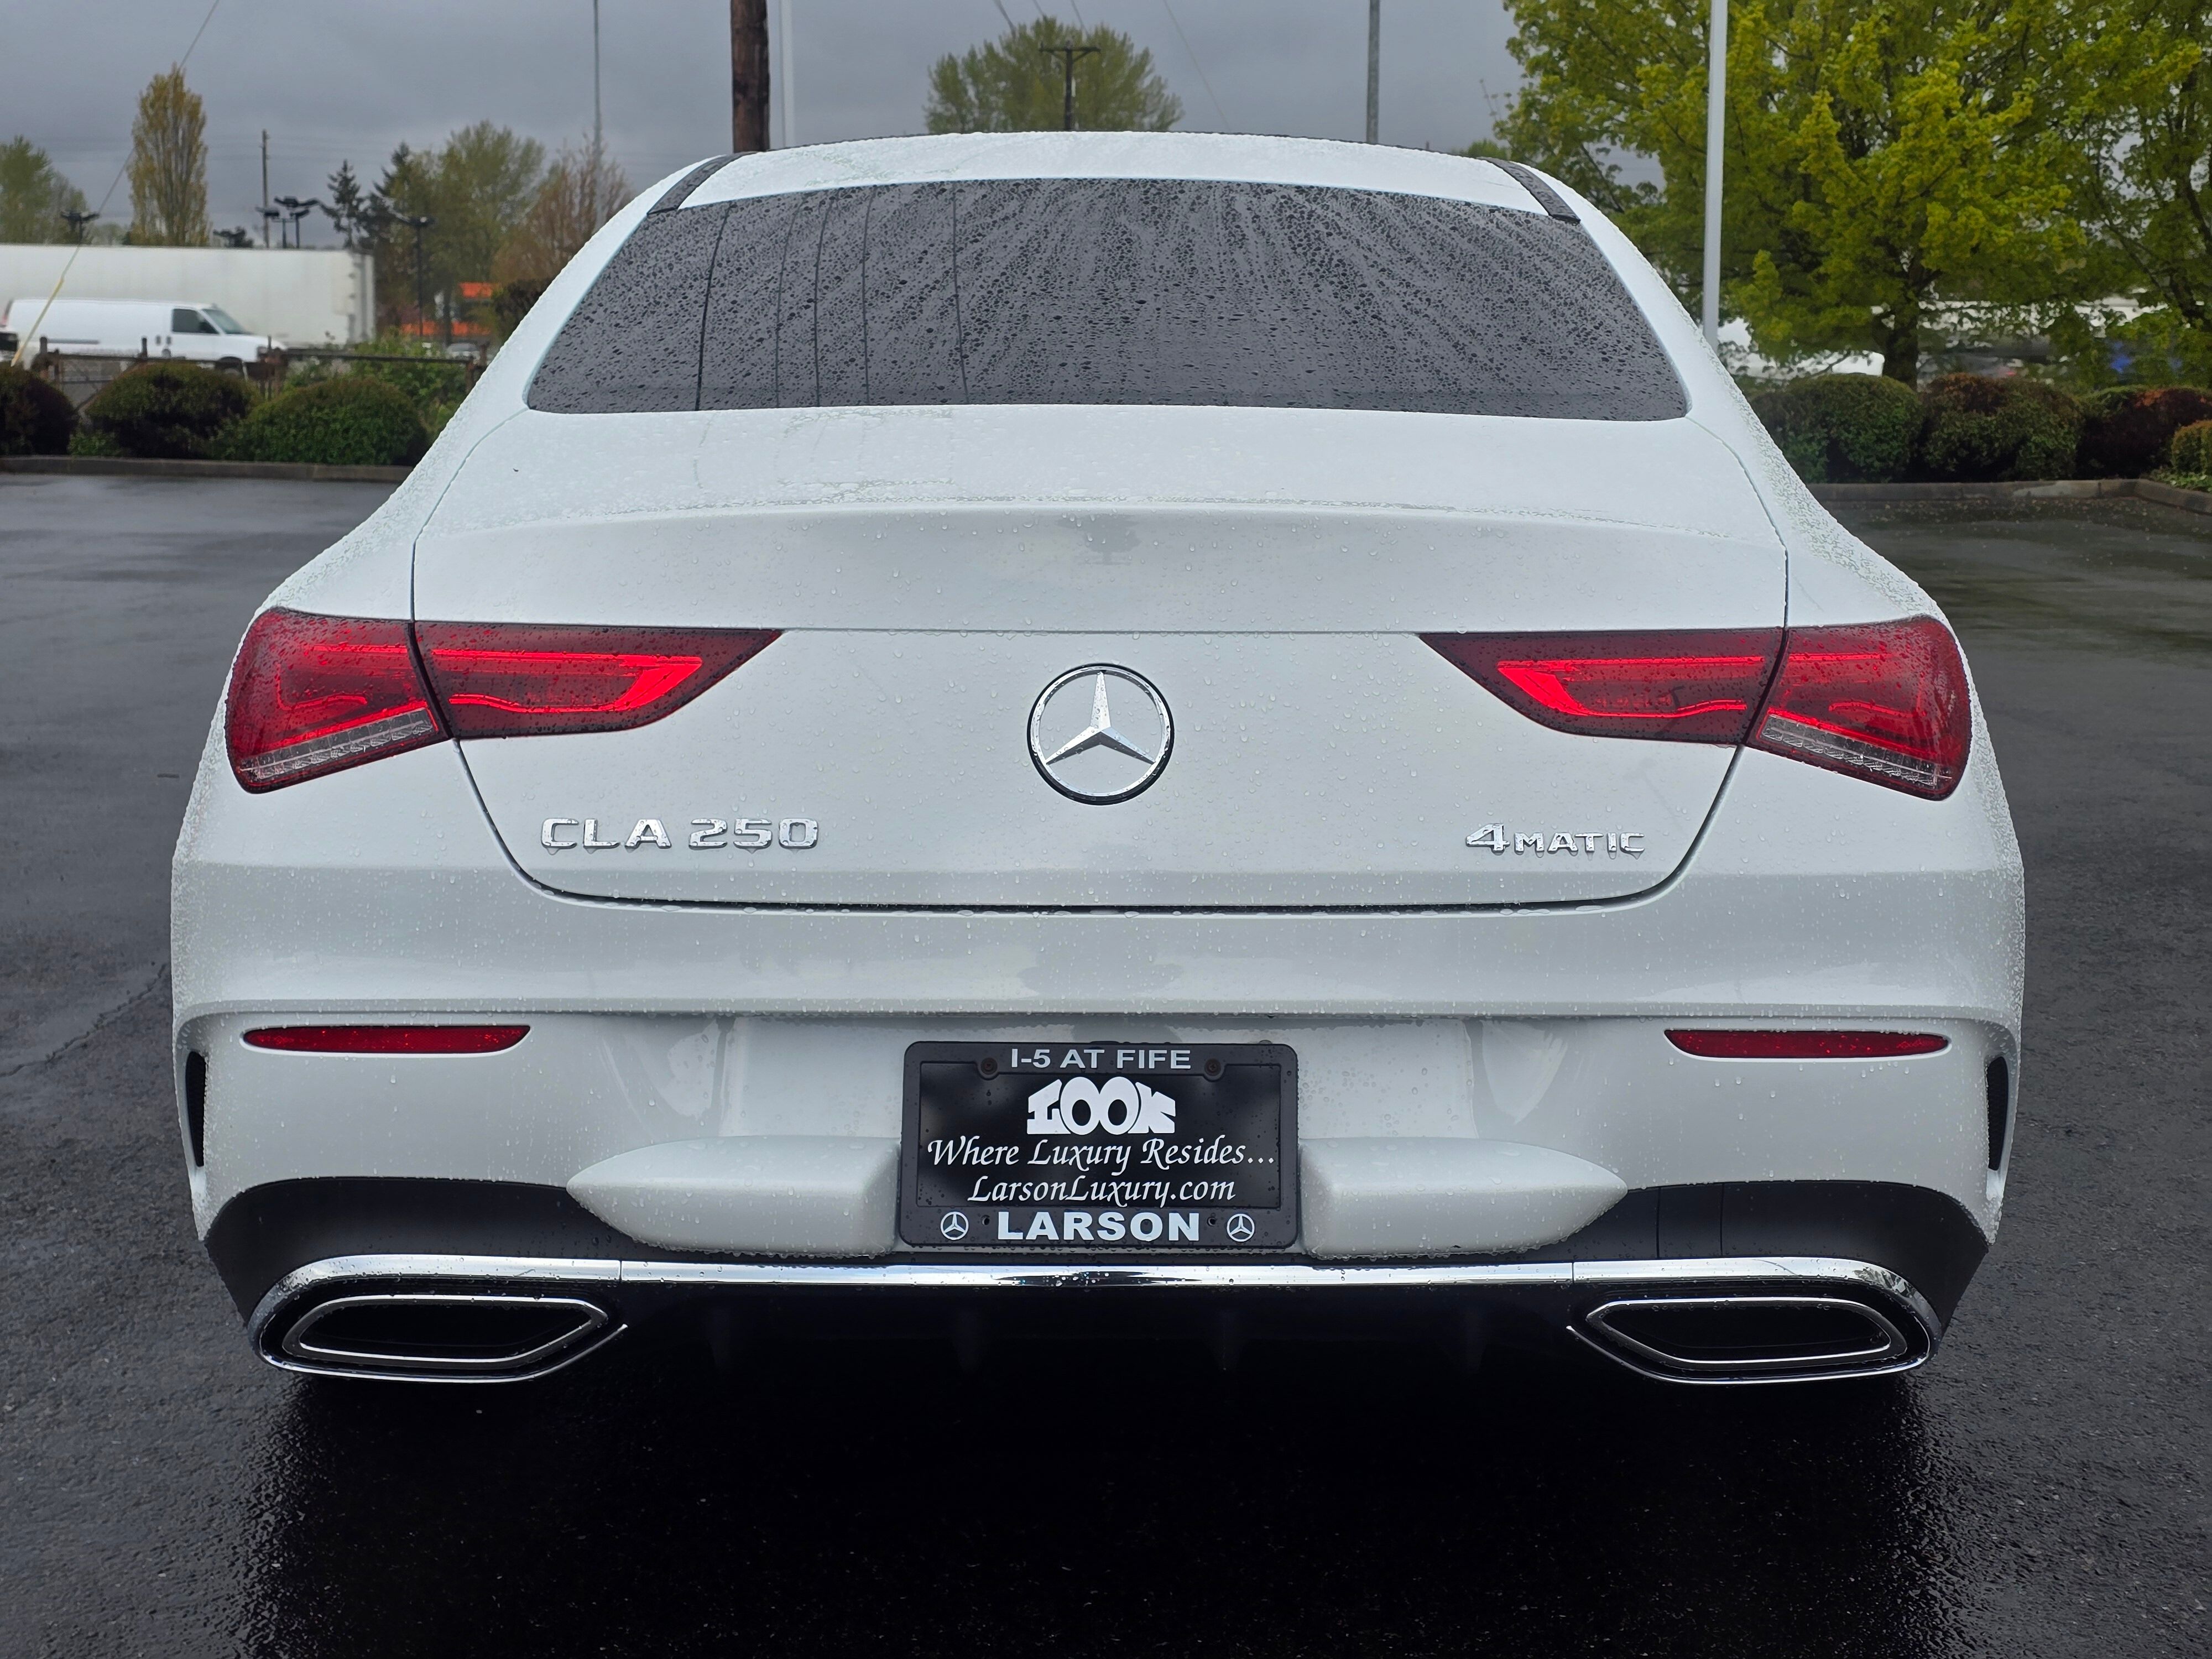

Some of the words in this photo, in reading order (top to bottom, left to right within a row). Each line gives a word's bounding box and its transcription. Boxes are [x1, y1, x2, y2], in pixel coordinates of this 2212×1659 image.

[541, 818, 671, 849] CLA
[688, 818, 818, 849] 250
[1465, 824, 1645, 853] 4MATIC
[1011, 1049, 1051, 1068] I-5
[1060, 1049, 1104, 1068] AT
[1117, 1050, 1191, 1070] FIFE
[1027, 1076, 1176, 1135] LOOK
[927, 1135, 1019, 1166] Where
[1027, 1140, 1131, 1176] Luxury
[1142, 1135, 1275, 1167] Resides...
[967, 1176, 1236, 1208] LarsonLuxury.com
[998, 1211, 1199, 1241] LARSON
